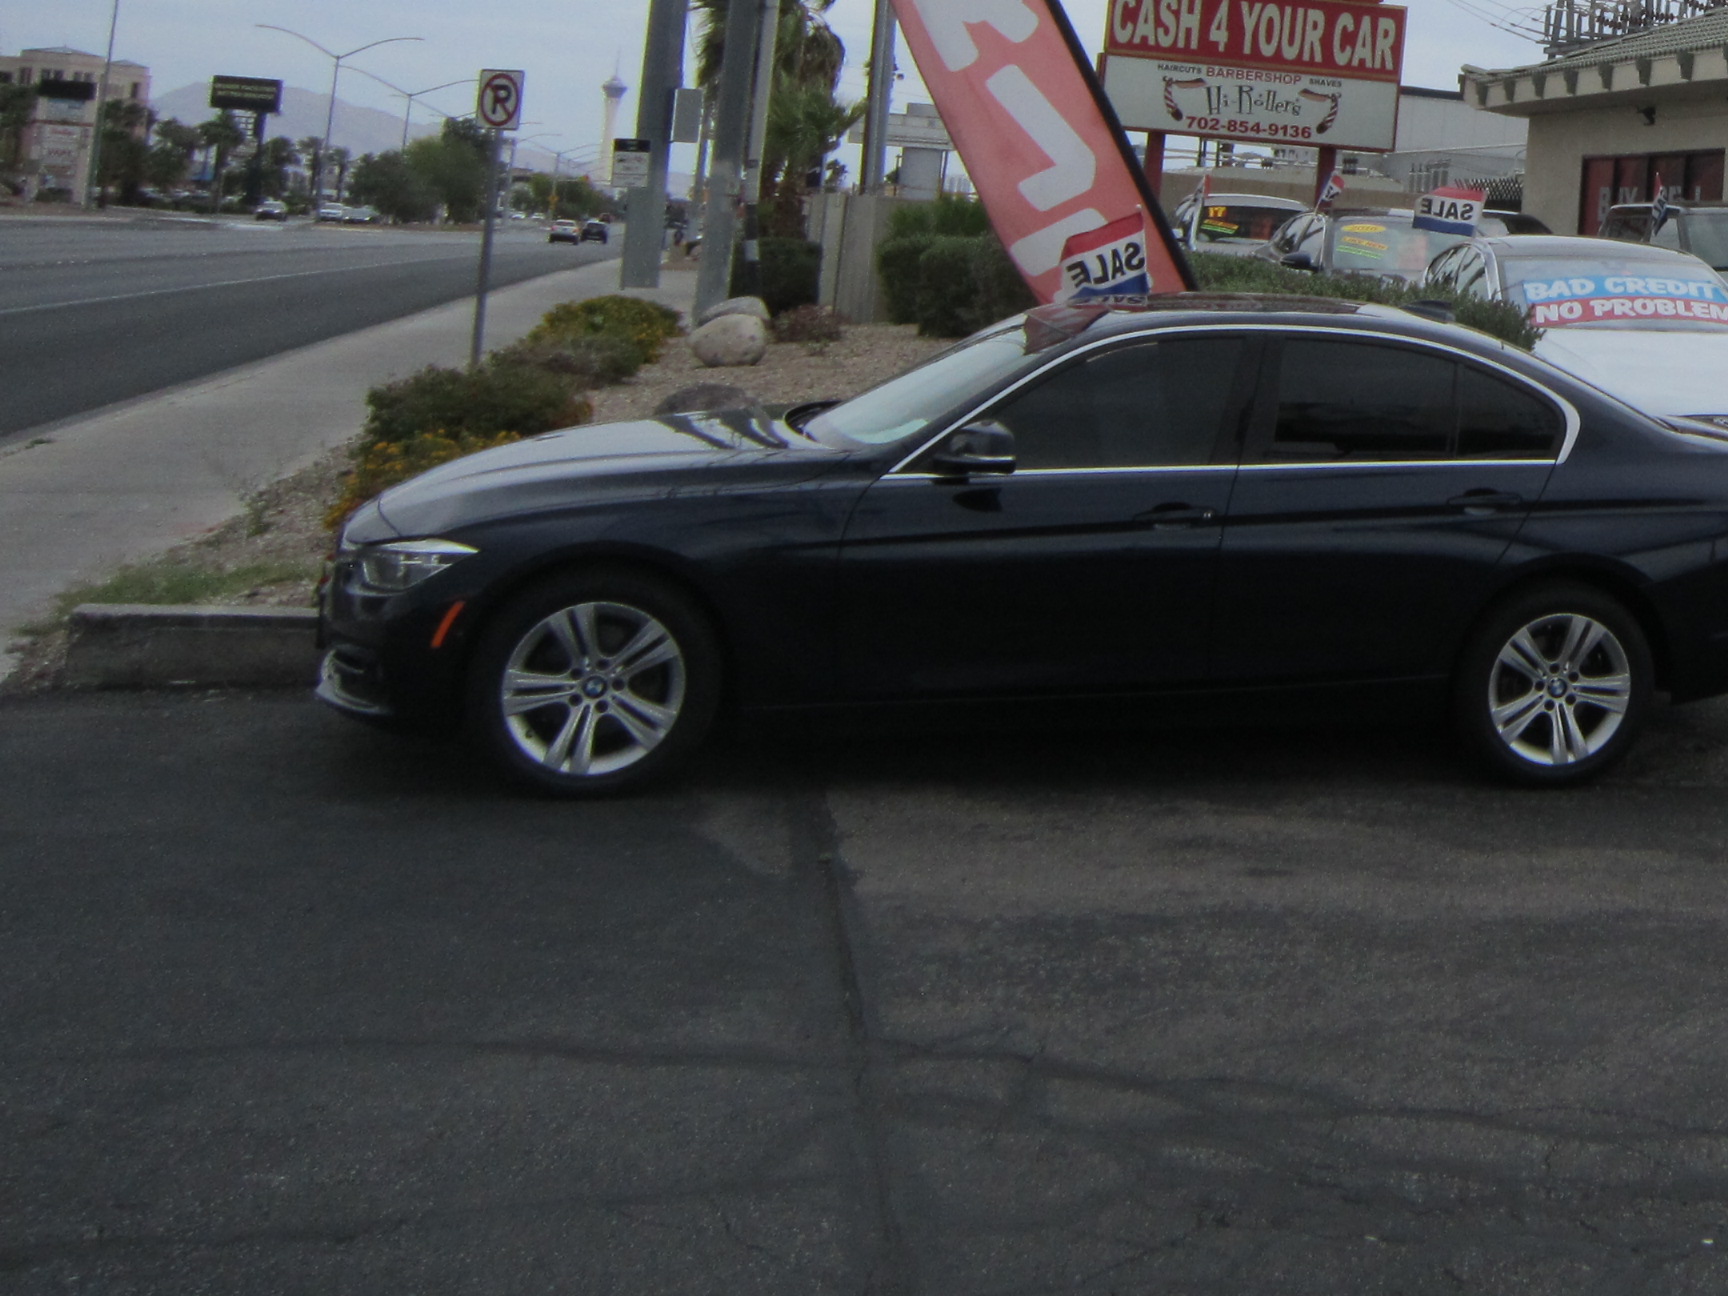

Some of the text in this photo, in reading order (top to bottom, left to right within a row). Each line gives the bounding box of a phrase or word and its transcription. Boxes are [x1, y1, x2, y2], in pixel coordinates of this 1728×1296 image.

[1240, 0, 1326, 63] YOUR
[1332, 11, 1397, 71] CAR
[1157, 63, 1202, 74] HAIRCUTS
[1206, 66, 1302, 85] BARBERSHOP
[1309, 77, 1342, 88] SHAVES
[1186, 115, 1312, 139] 702-854-9136
[1523, 276, 1719, 301] BAD CREDIT
[1535, 301, 1583, 324] NO
